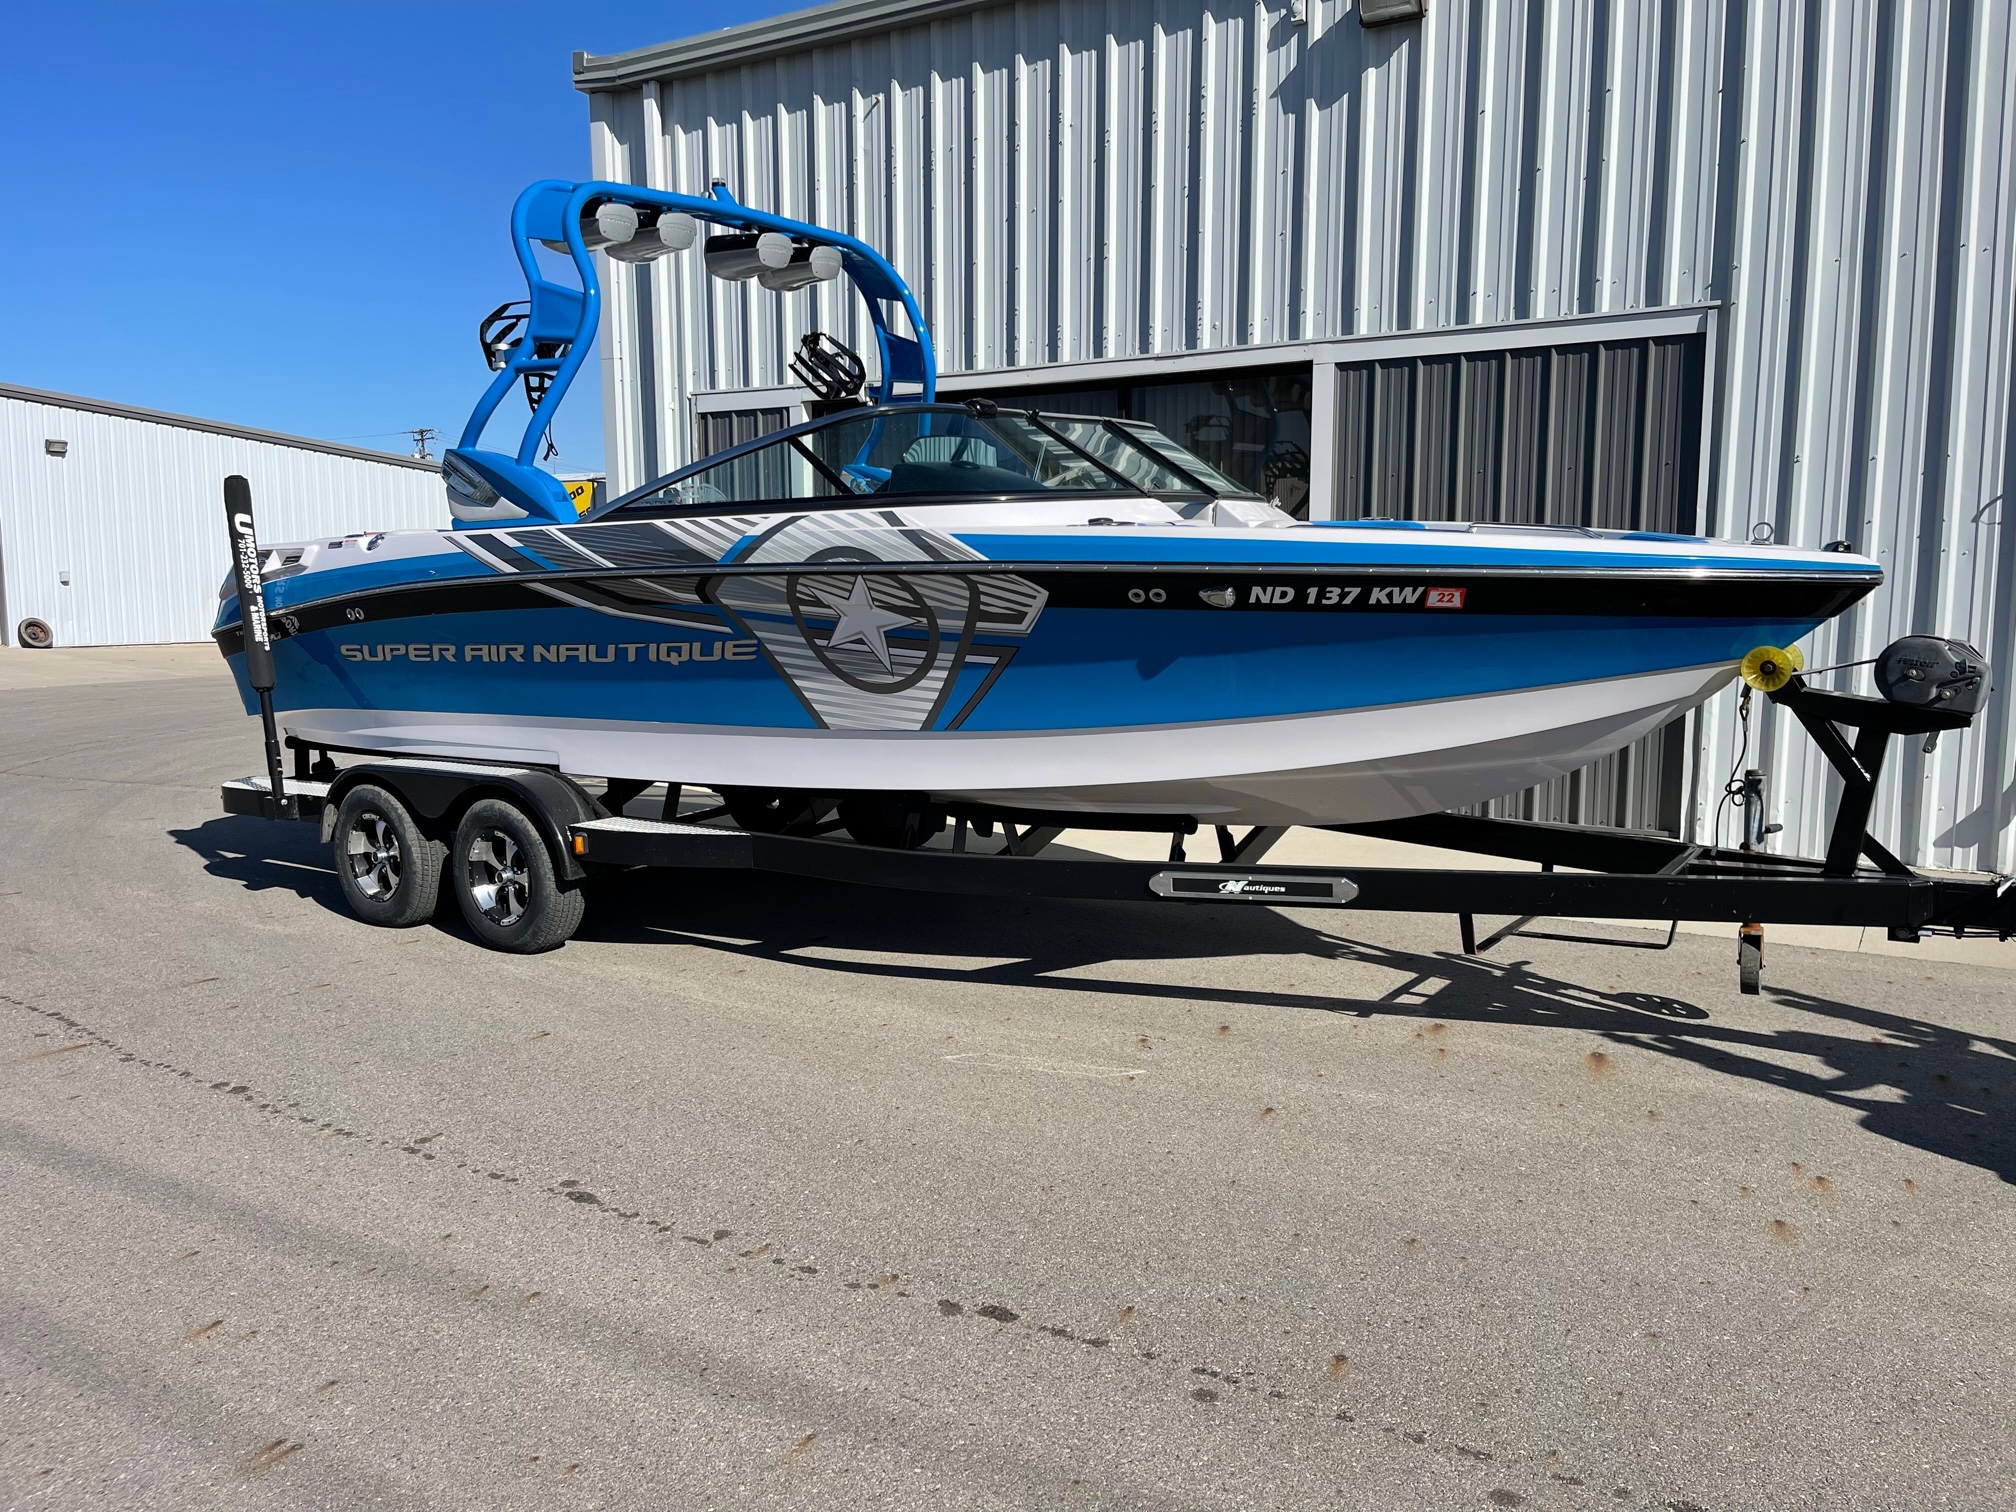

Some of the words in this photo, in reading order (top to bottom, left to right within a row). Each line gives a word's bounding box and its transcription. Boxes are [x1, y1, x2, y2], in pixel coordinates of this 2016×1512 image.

[237, 538, 253, 589] 701-232-5000
[1249, 586, 1295, 604] ND
[1306, 586, 1361, 604] 137
[1368, 586, 1425, 604] KW
[1436, 592, 1455, 603] 22
[251, 612, 263, 643] MARINE
[256, 595, 270, 651] MOTORSPORTS
[340, 643, 457, 663] SUPER
[464, 643, 526, 663] AIR
[533, 639, 759, 666] NAUTIQUE
[1218, 880, 1286, 894] Nautiques
